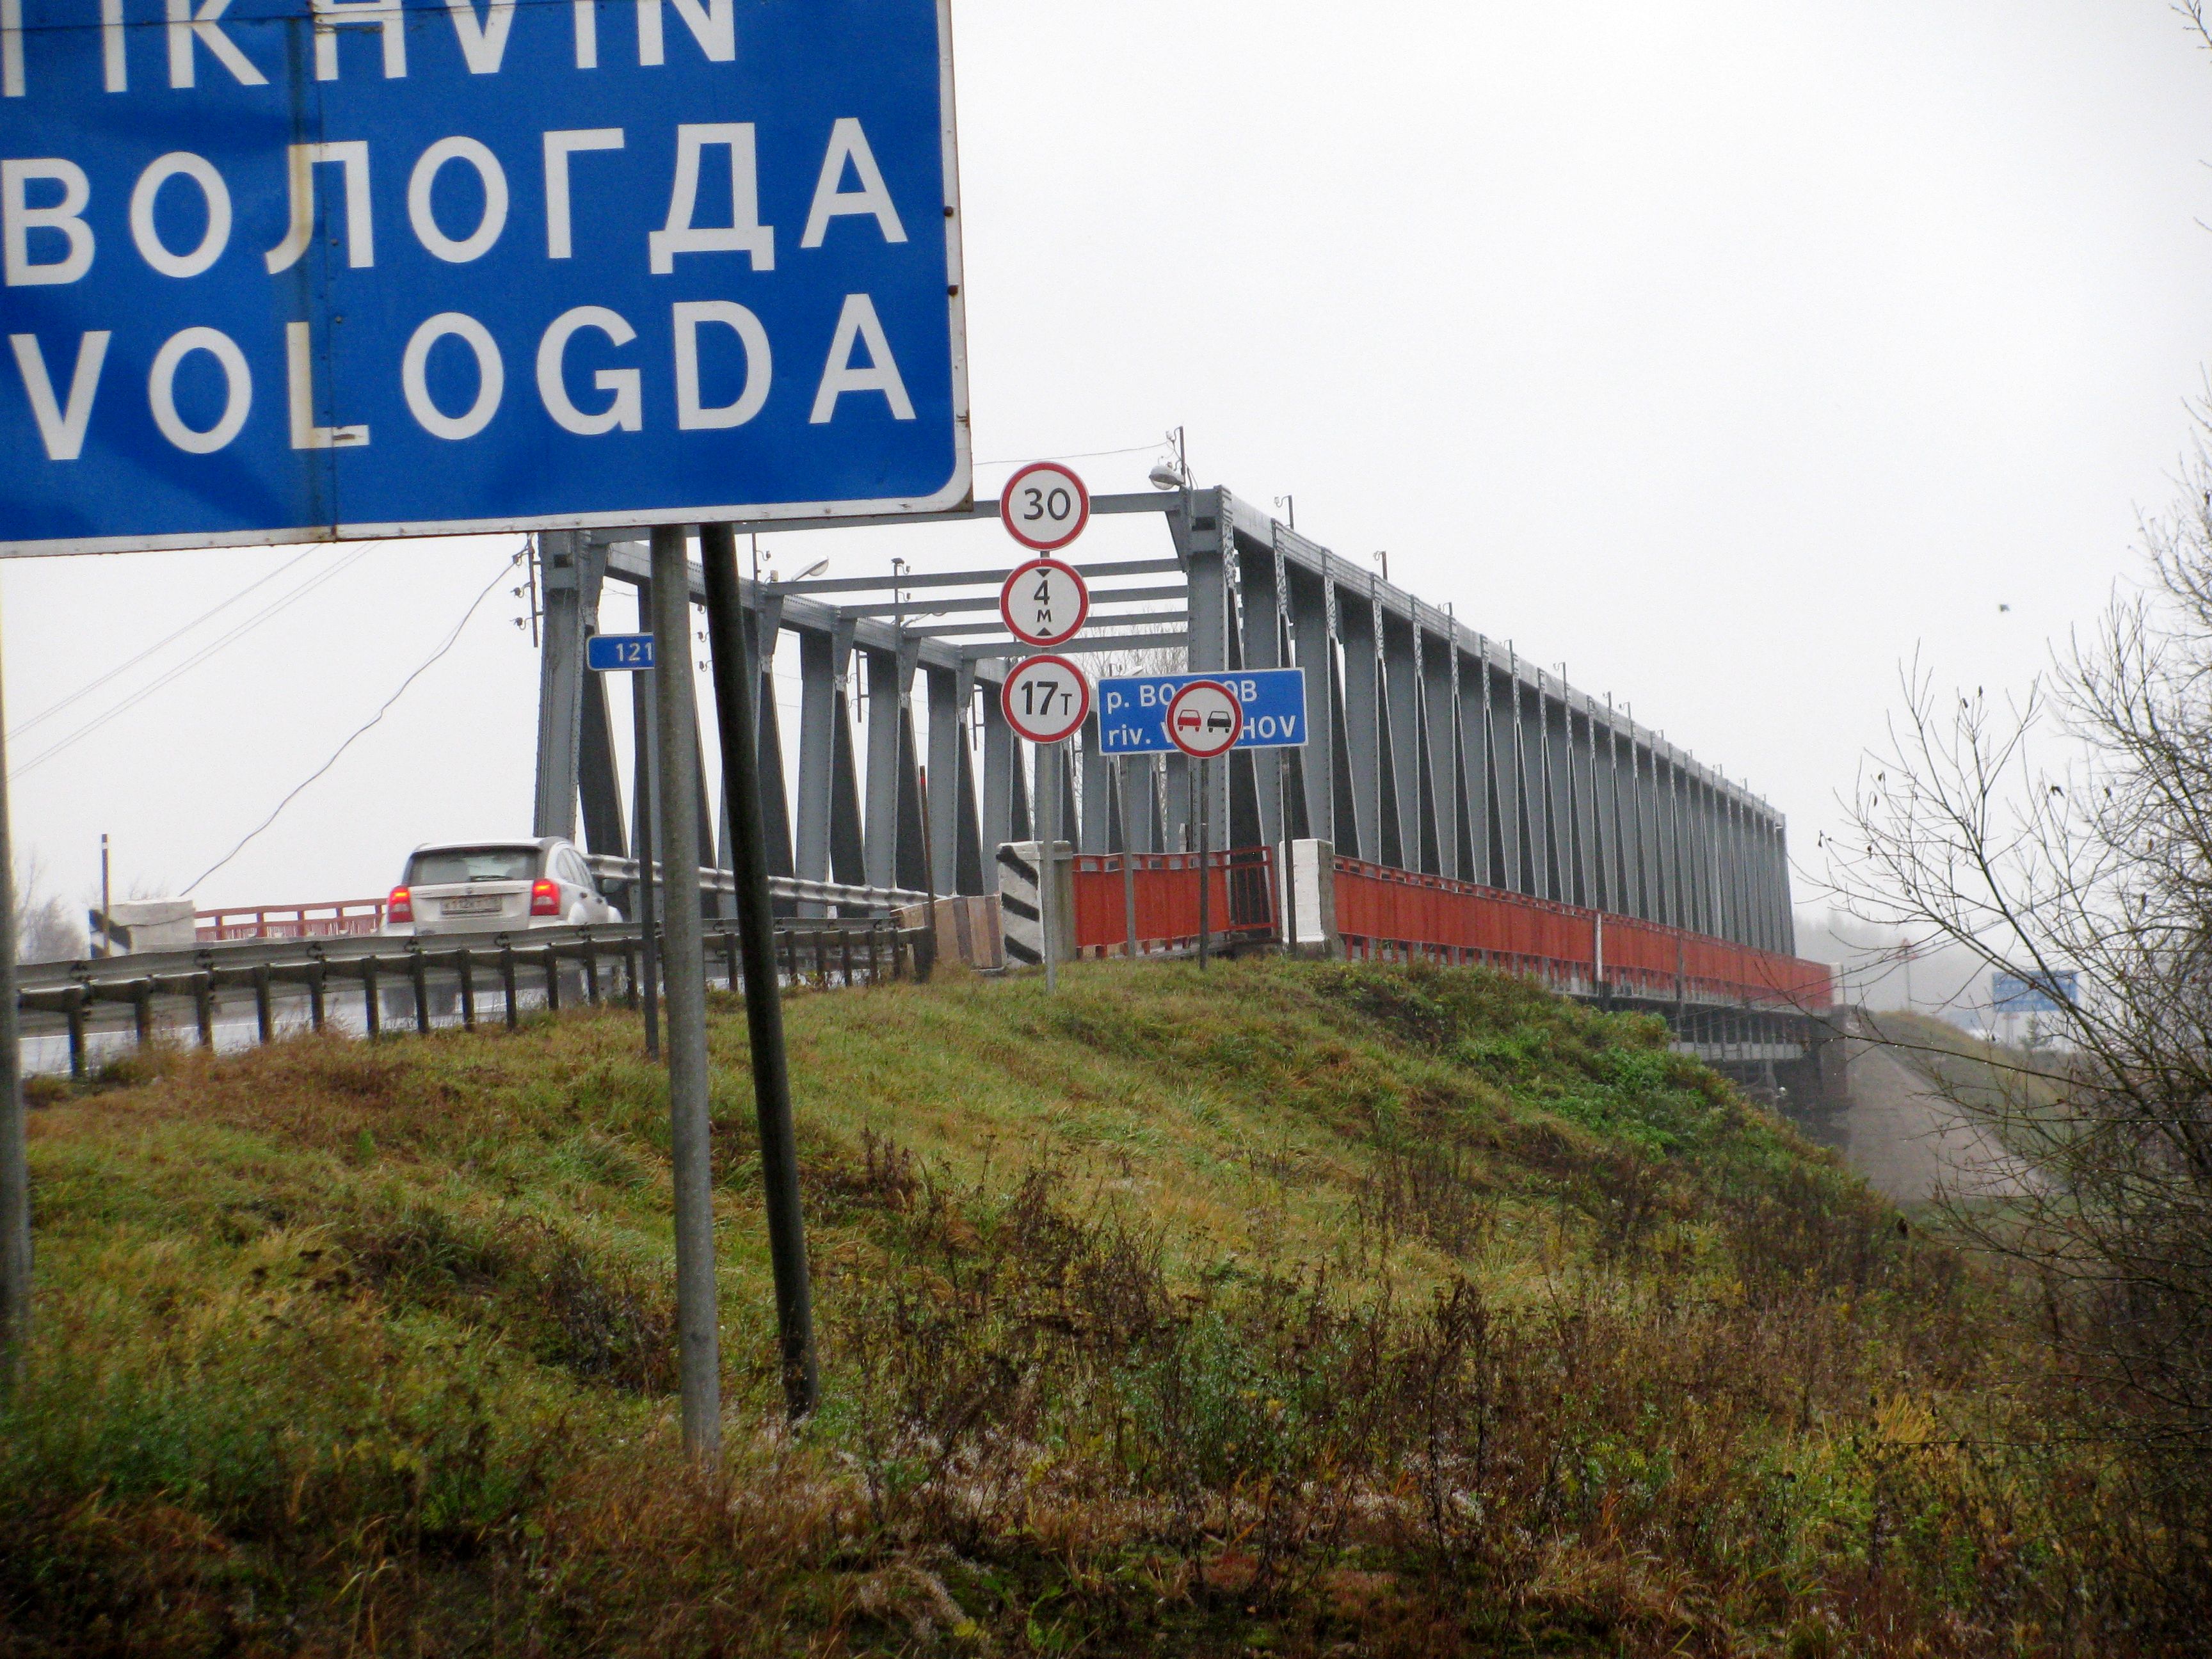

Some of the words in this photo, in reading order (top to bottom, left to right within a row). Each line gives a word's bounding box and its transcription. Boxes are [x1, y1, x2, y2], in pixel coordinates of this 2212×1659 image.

[1, 118, 909, 285] ВОЛОГДА
[10, 294, 917, 460] VOLOGDA
[1023, 487, 1071, 521] 30
[1033, 579, 1050, 605] 4
[616, 642, 652, 661] 121
[1107, 691, 1130, 714] р.
[1108, 724, 1151, 746] riv.
